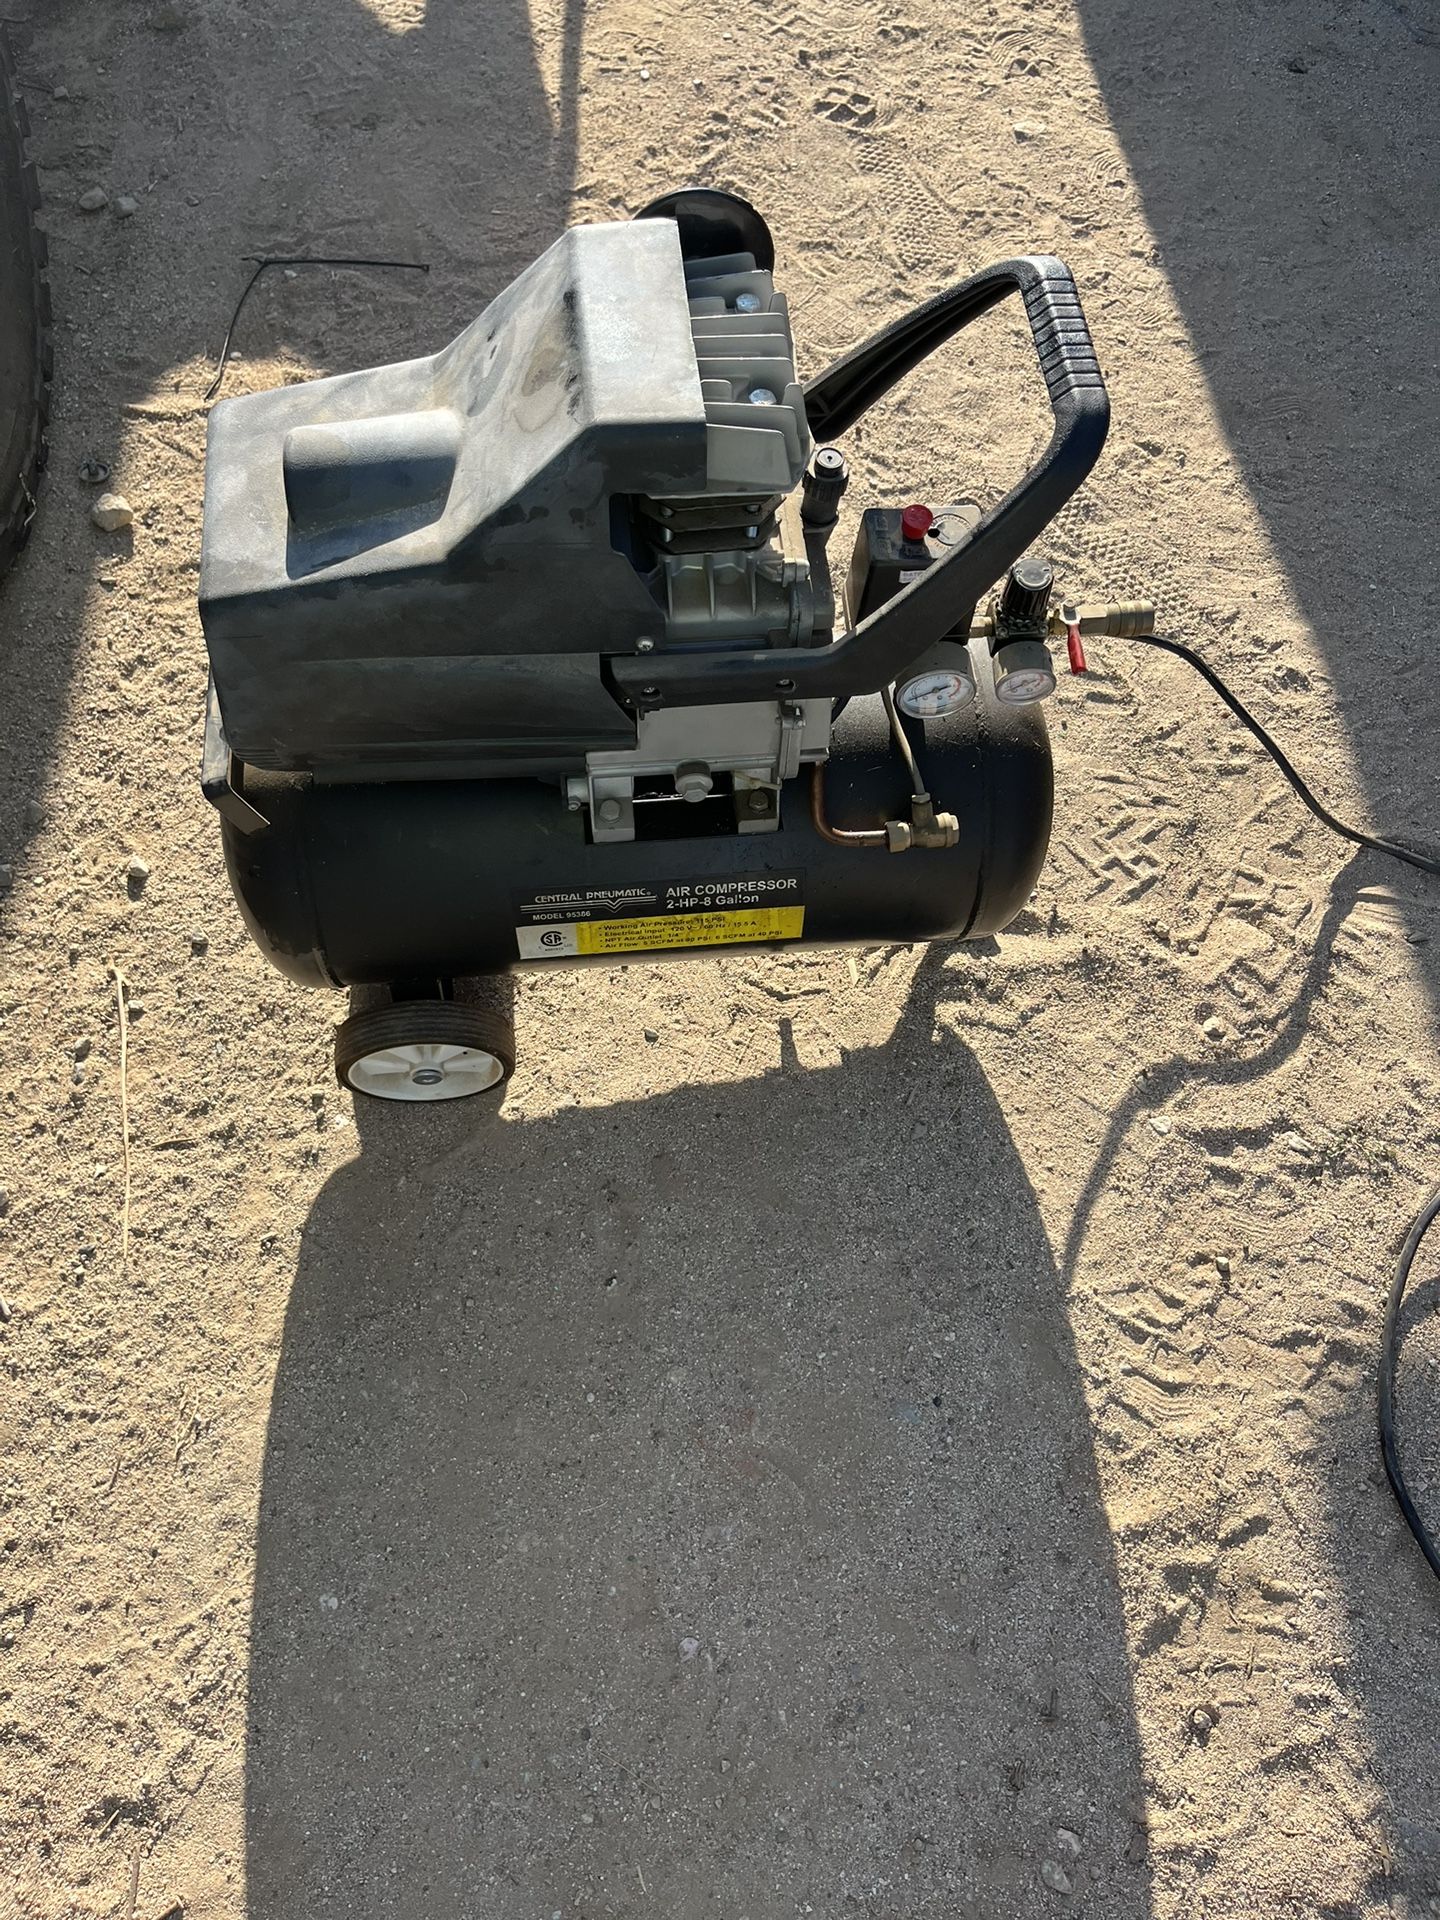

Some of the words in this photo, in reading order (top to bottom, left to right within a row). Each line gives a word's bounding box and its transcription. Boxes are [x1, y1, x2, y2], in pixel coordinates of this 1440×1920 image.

[666, 886, 690, 898] AIR
[695, 879, 797, 896] COMPRESSOR
[535, 893, 582, 904] CENTRAL
[586, 888, 646, 900] PNEUMATIC
[666, 896, 711, 909] 2-HP-8
[533, 912, 564, 920] MODEL
[604, 923, 638, 931] Working
[604, 929, 642, 937] Electrical
